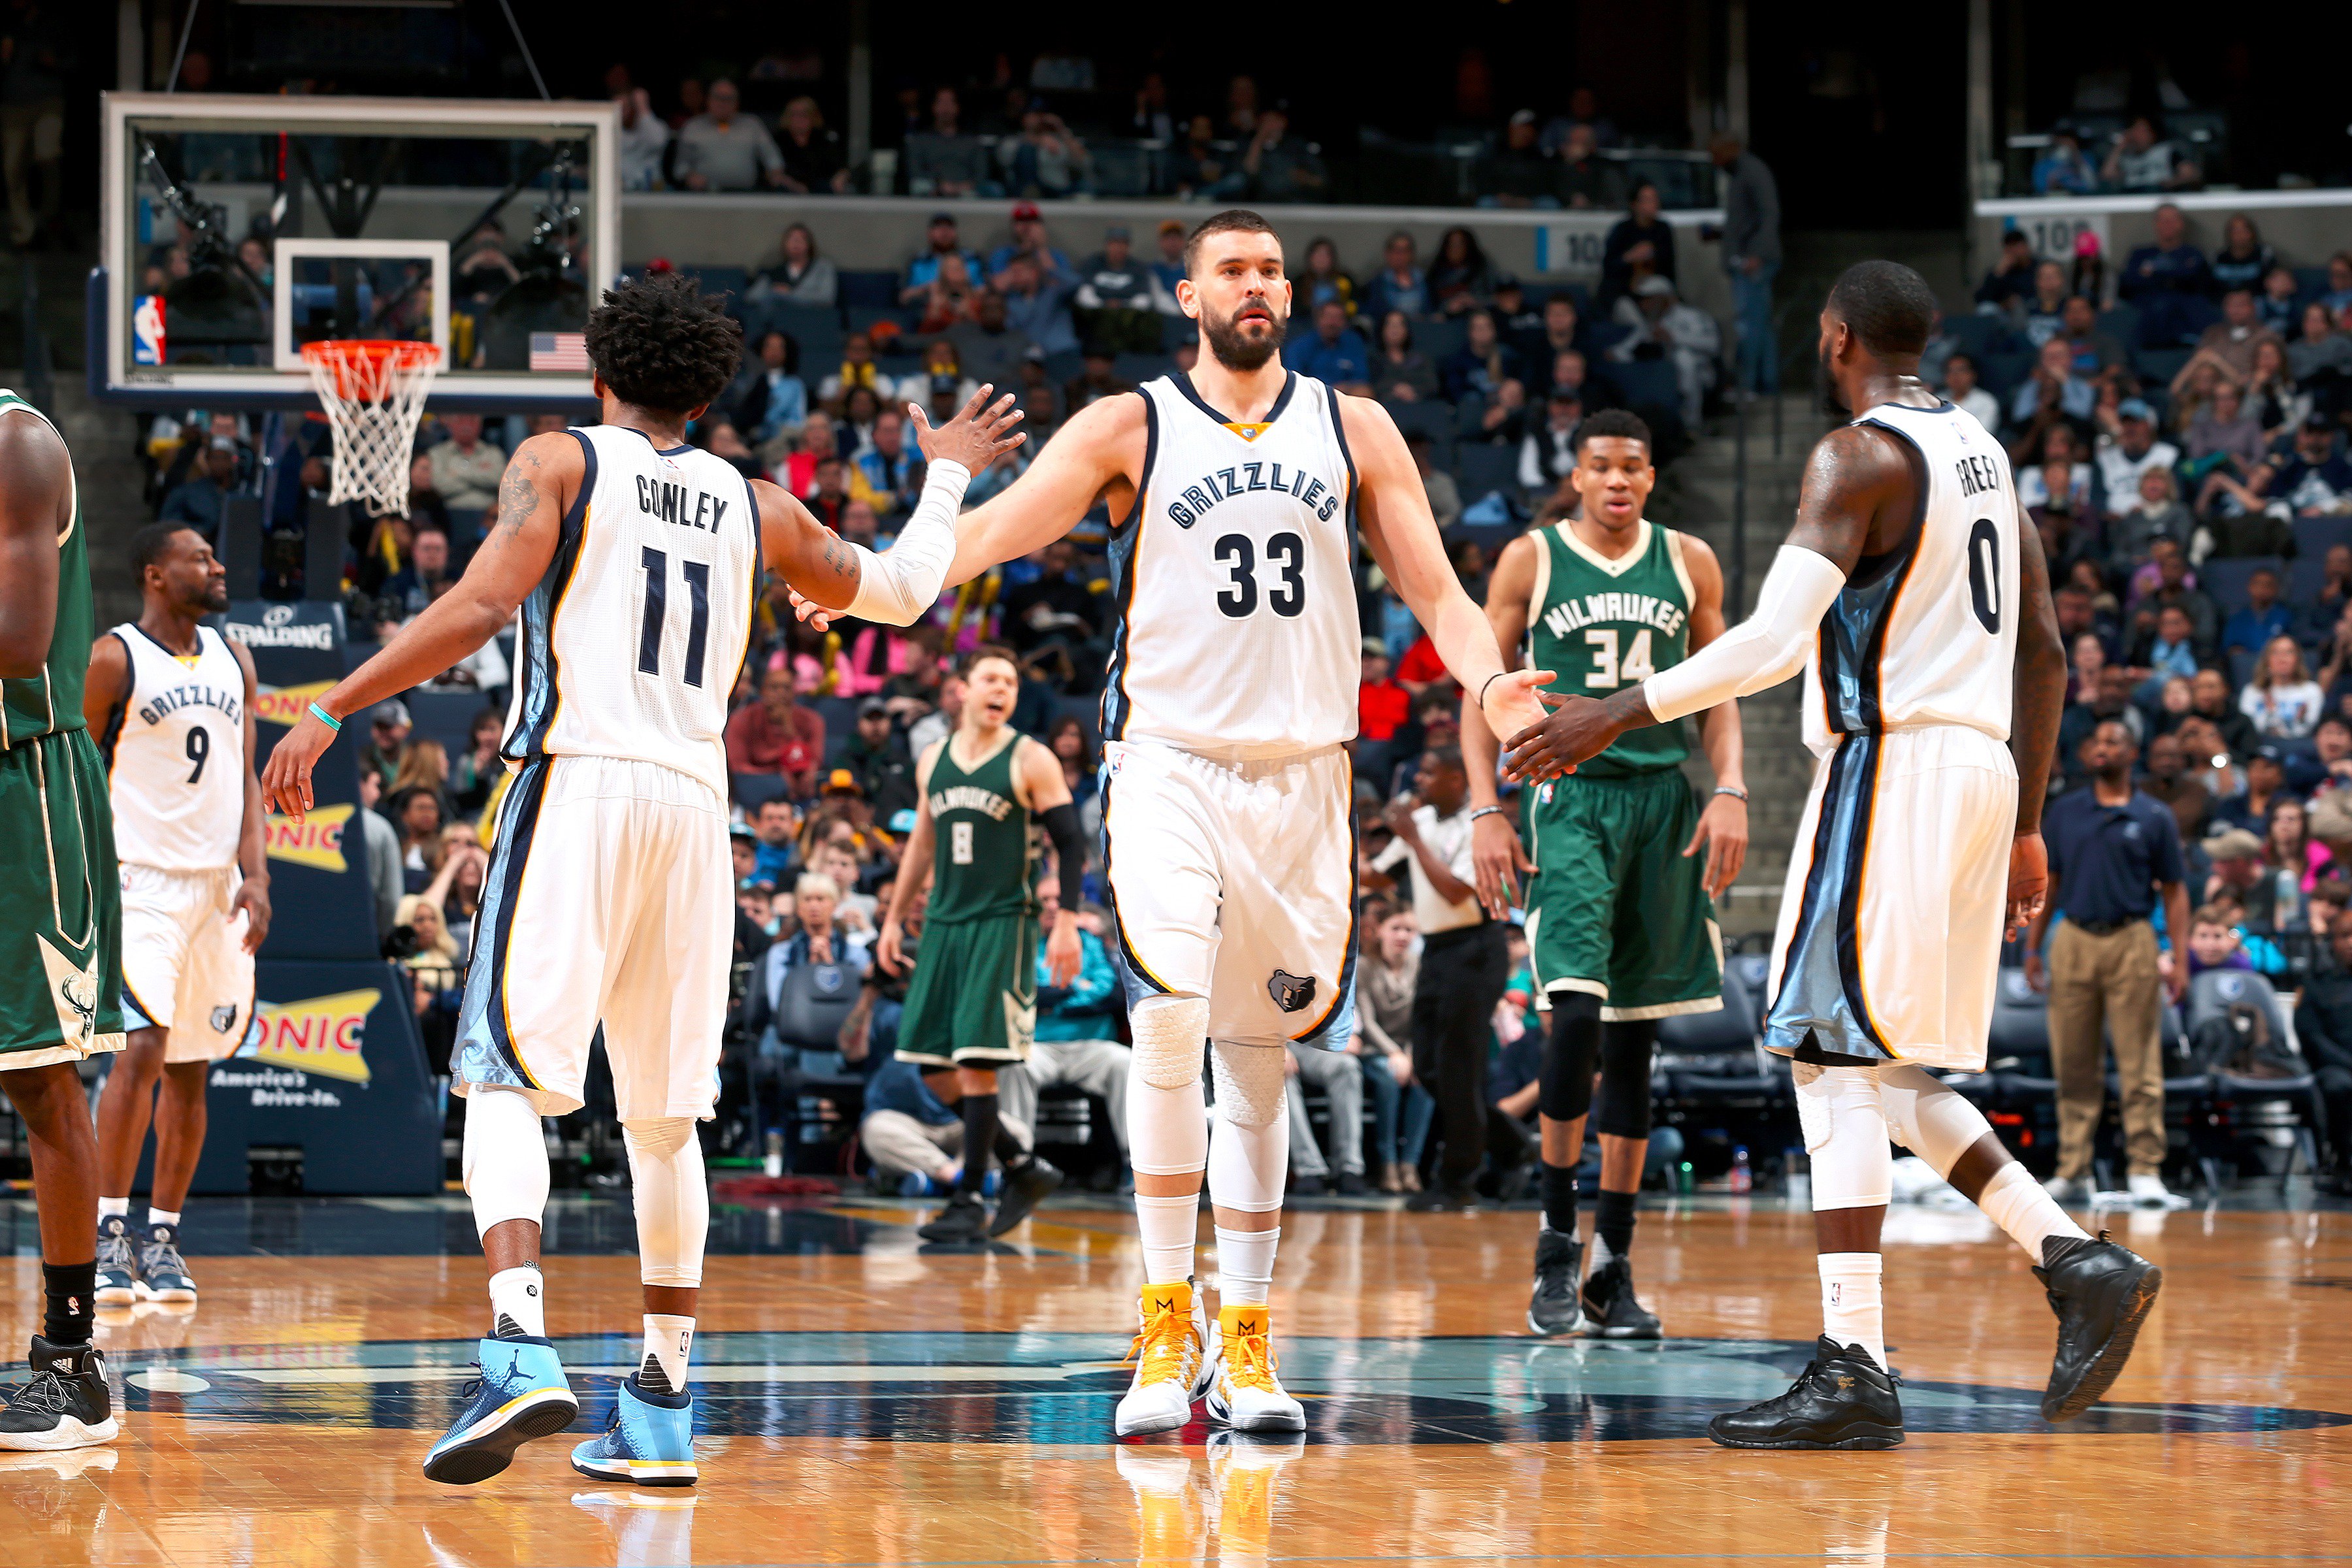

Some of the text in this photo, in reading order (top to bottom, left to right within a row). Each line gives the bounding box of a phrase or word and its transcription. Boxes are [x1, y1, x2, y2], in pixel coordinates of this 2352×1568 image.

[636, 474, 728, 534] CONLEY
[1168, 461, 1339, 530] GRIZZLIES
[1955, 455, 2001, 498] GREE
[1214, 532, 1306, 618] 33
[1968, 518, 2002, 635] 0
[224, 622, 333, 651] SPALDING
[638, 545, 711, 689] 11
[1543, 592, 1686, 640] MILWAUKEE
[1584, 629, 1656, 689] 34
[253, 693, 310, 717] ONI
[186, 725, 210, 784] 9
[952, 821, 973, 864] 8
